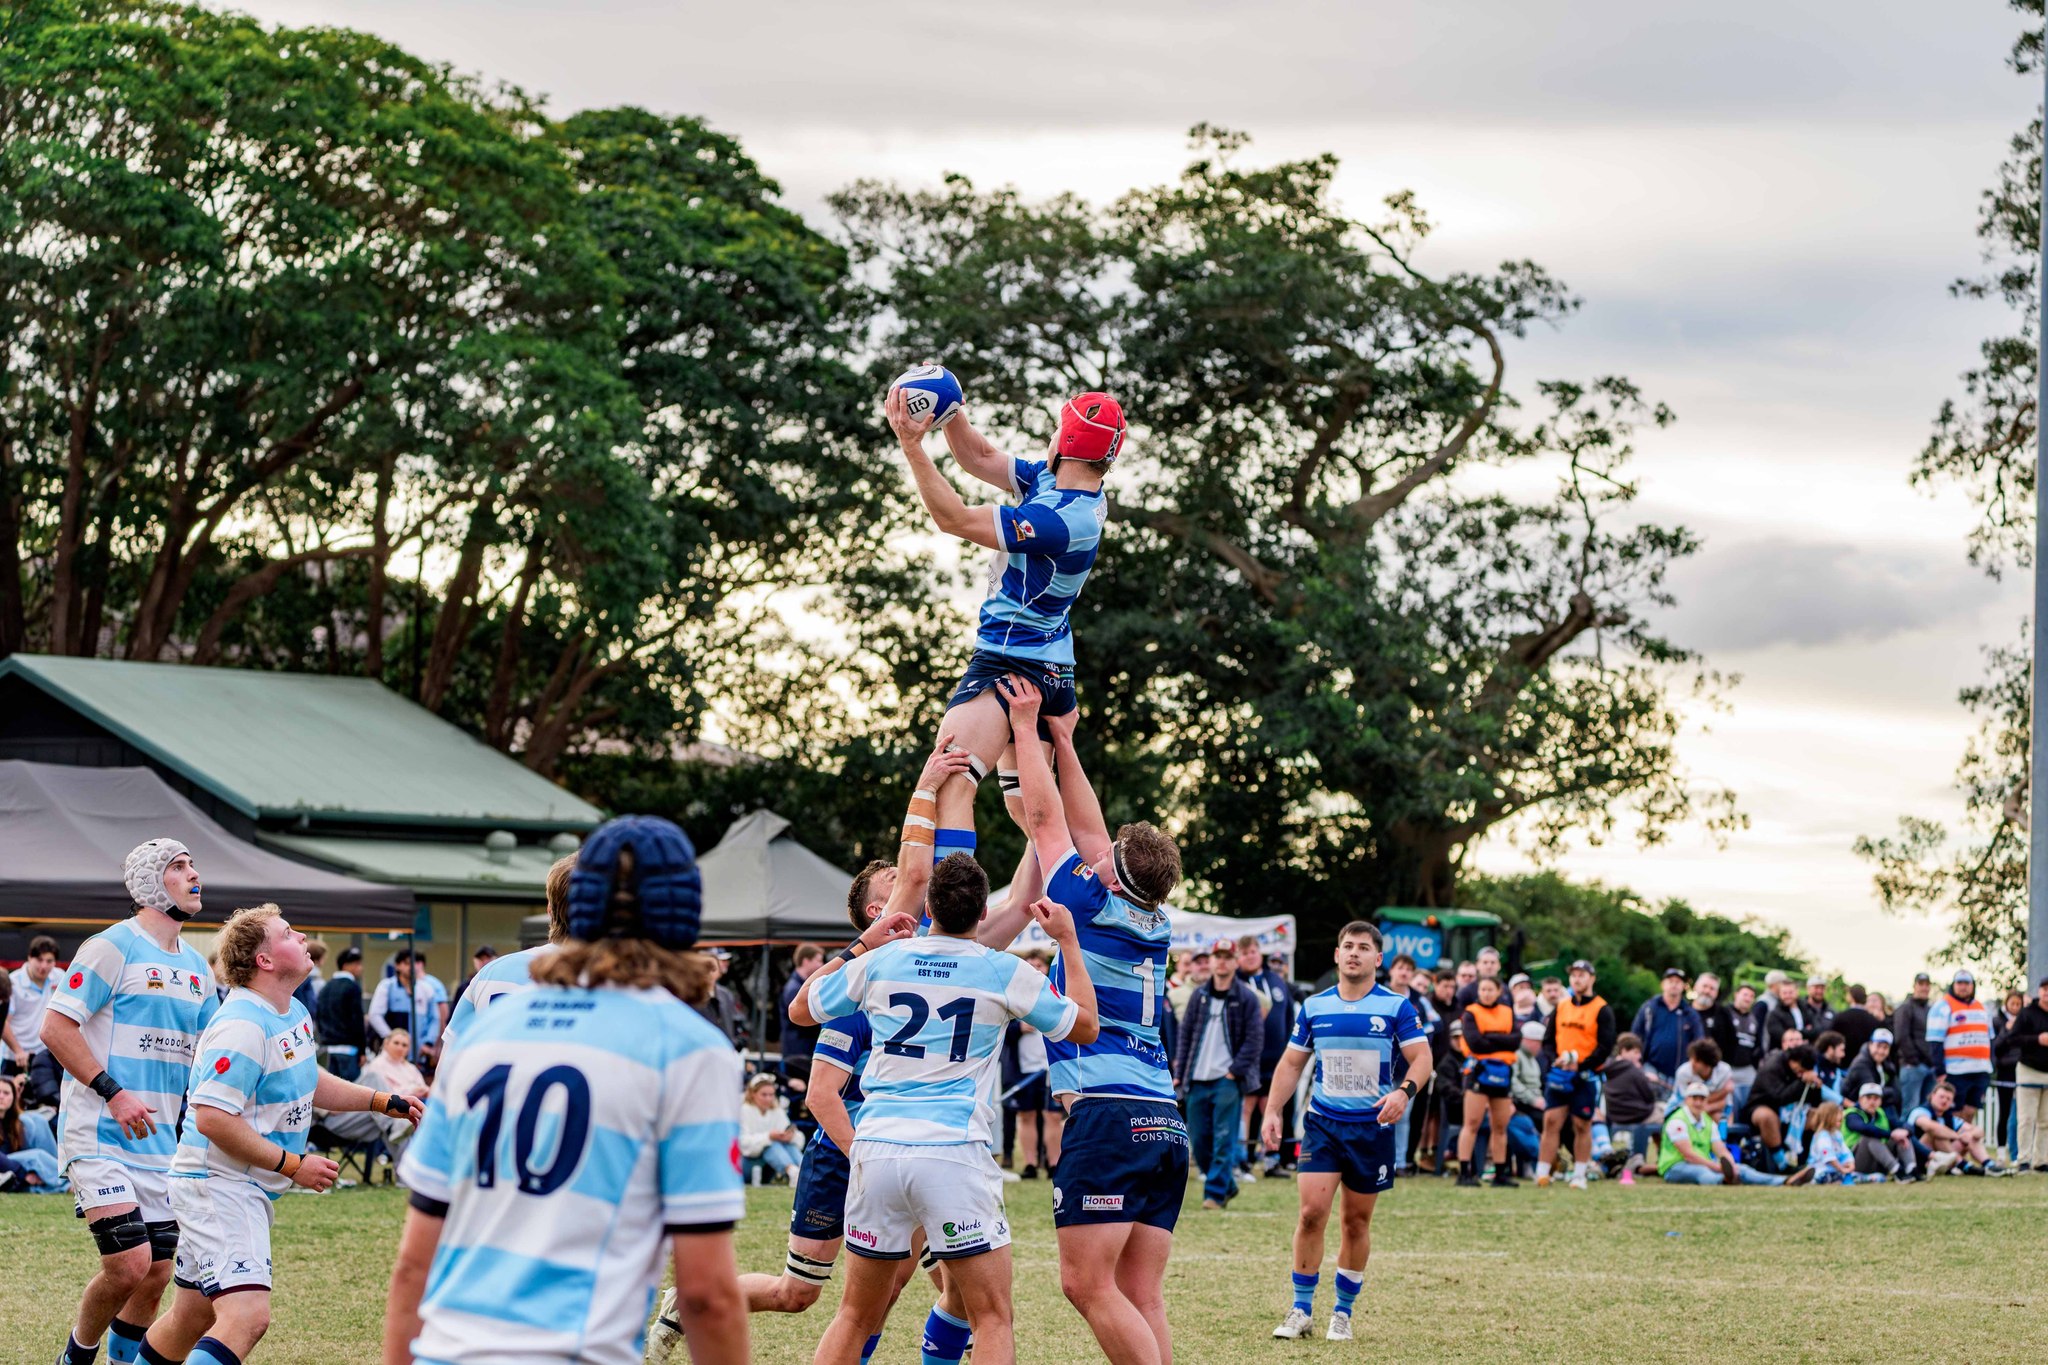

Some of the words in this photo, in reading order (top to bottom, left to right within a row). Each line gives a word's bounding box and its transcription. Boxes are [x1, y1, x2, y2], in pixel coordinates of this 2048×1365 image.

[914, 959, 928, 967] OLD
[929, 960, 958, 968] SOLDIER
[918, 968, 932, 978] EST.
[933, 969, 950, 979] 1919
[1132, 957, 1155, 1027] 1
[884, 992, 976, 1063] 21
[1326, 1056, 1352, 1073] THE
[1130, 1116, 1167, 1127] RICHARD
[466, 1064, 591, 1196] 10
[97, 1187, 112, 1196] EST.
[112, 1184, 126, 1194] 1919
